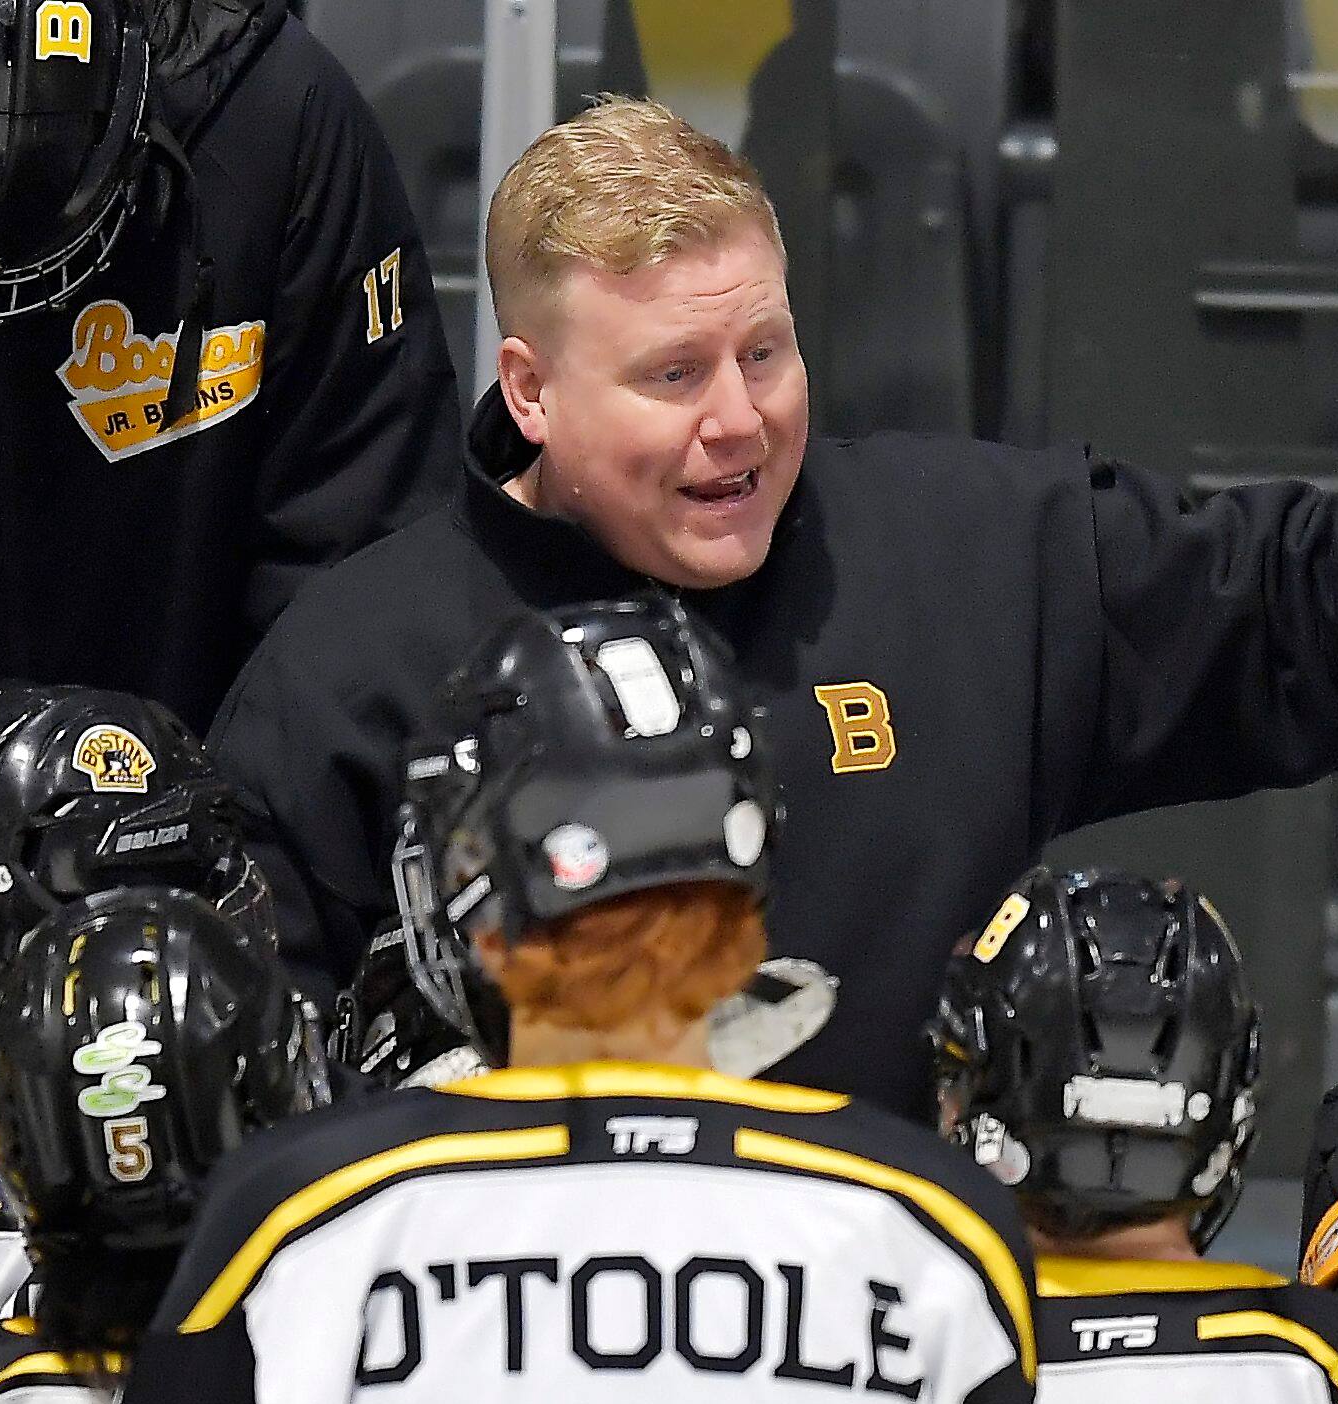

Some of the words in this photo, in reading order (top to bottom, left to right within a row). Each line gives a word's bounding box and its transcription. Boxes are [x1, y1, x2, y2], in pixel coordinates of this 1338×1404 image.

[36, 1, 91, 63] B
[364, 248, 403, 344] 17
[63, 302, 265, 391] Boson
[104, 410, 136, 436] JR.
[143, 381, 234, 425] BINS
[81, 733, 148, 769] BOSTON
[813, 681, 897, 774] B
[103, 1115, 153, 1182] 5
[355, 1256, 922, 1400] O'TOOLE
